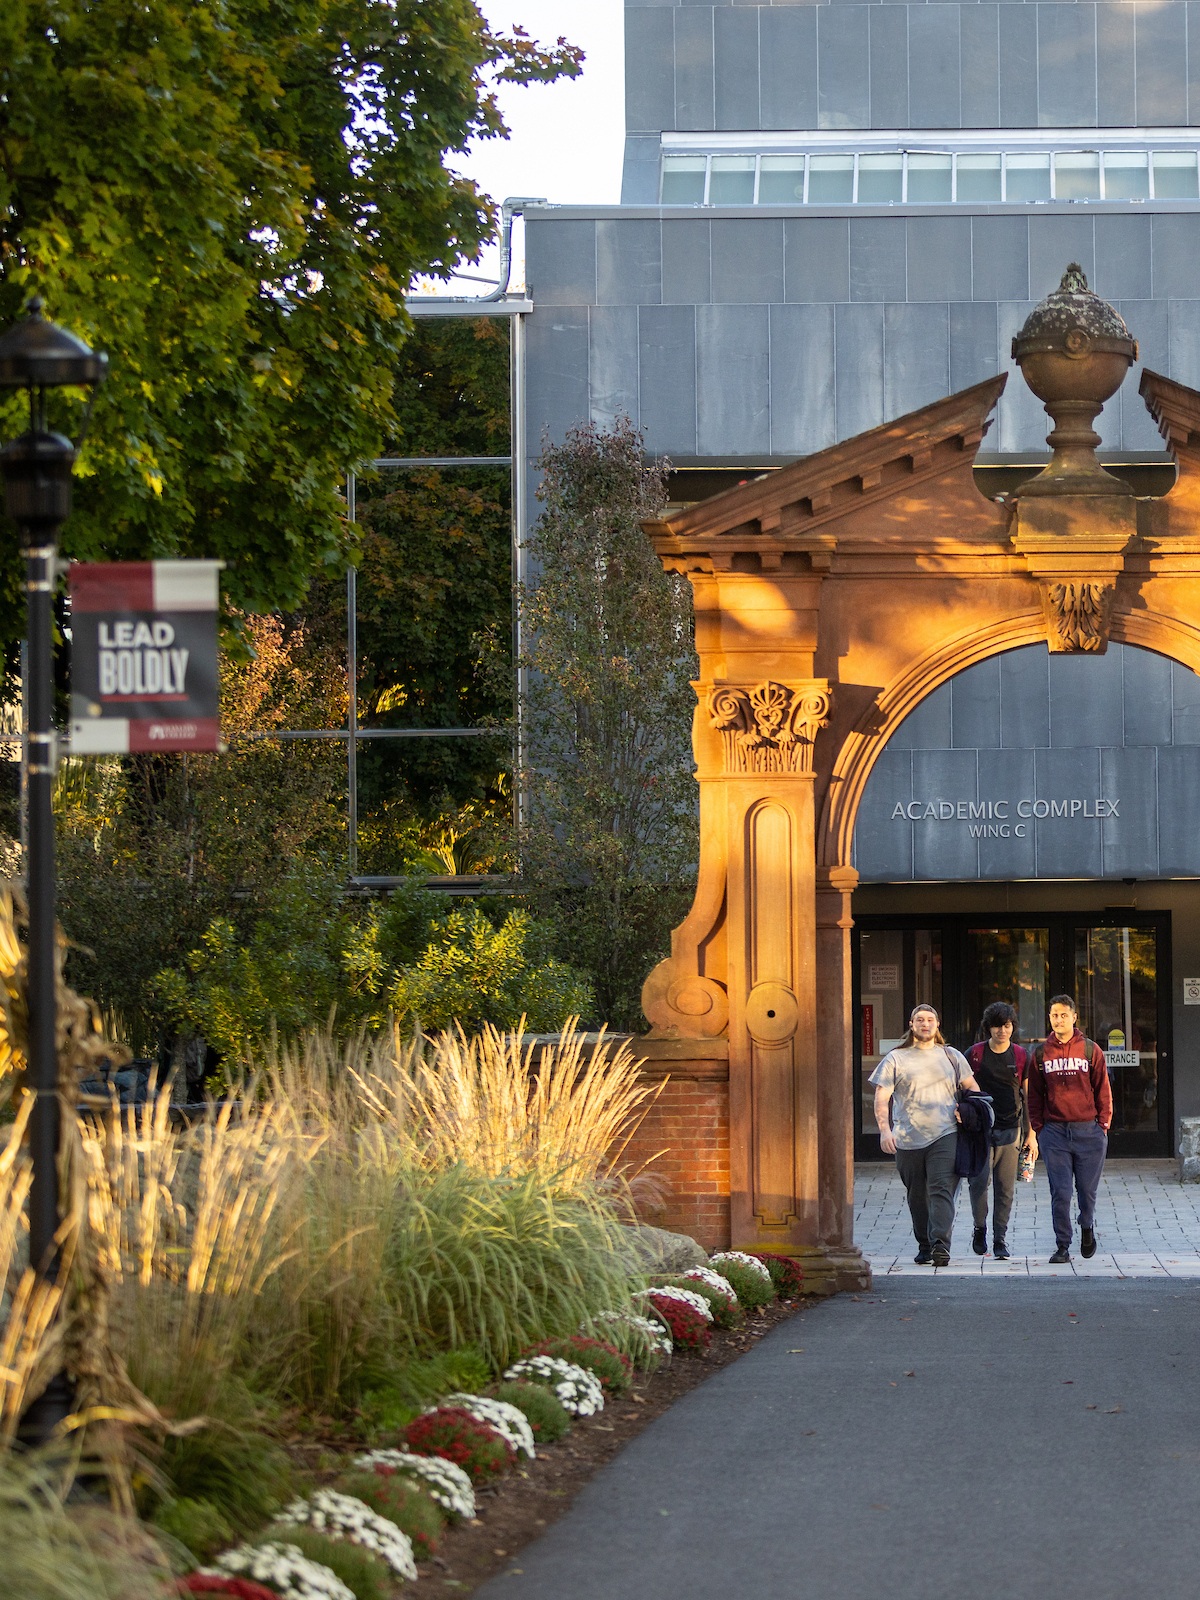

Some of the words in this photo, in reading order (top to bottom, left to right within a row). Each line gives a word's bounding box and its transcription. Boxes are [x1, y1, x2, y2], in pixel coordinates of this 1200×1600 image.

[98, 621, 176, 648] LEAD
[99, 649, 190, 695] BOLDLY
[891, 800, 1009, 820] ACADEMIC
[1016, 799, 1121, 819] COMPLEX
[968, 824, 1010, 838] WING
[1014, 823, 1026, 838] C
[1104, 1053, 1136, 1064] TRANCE
